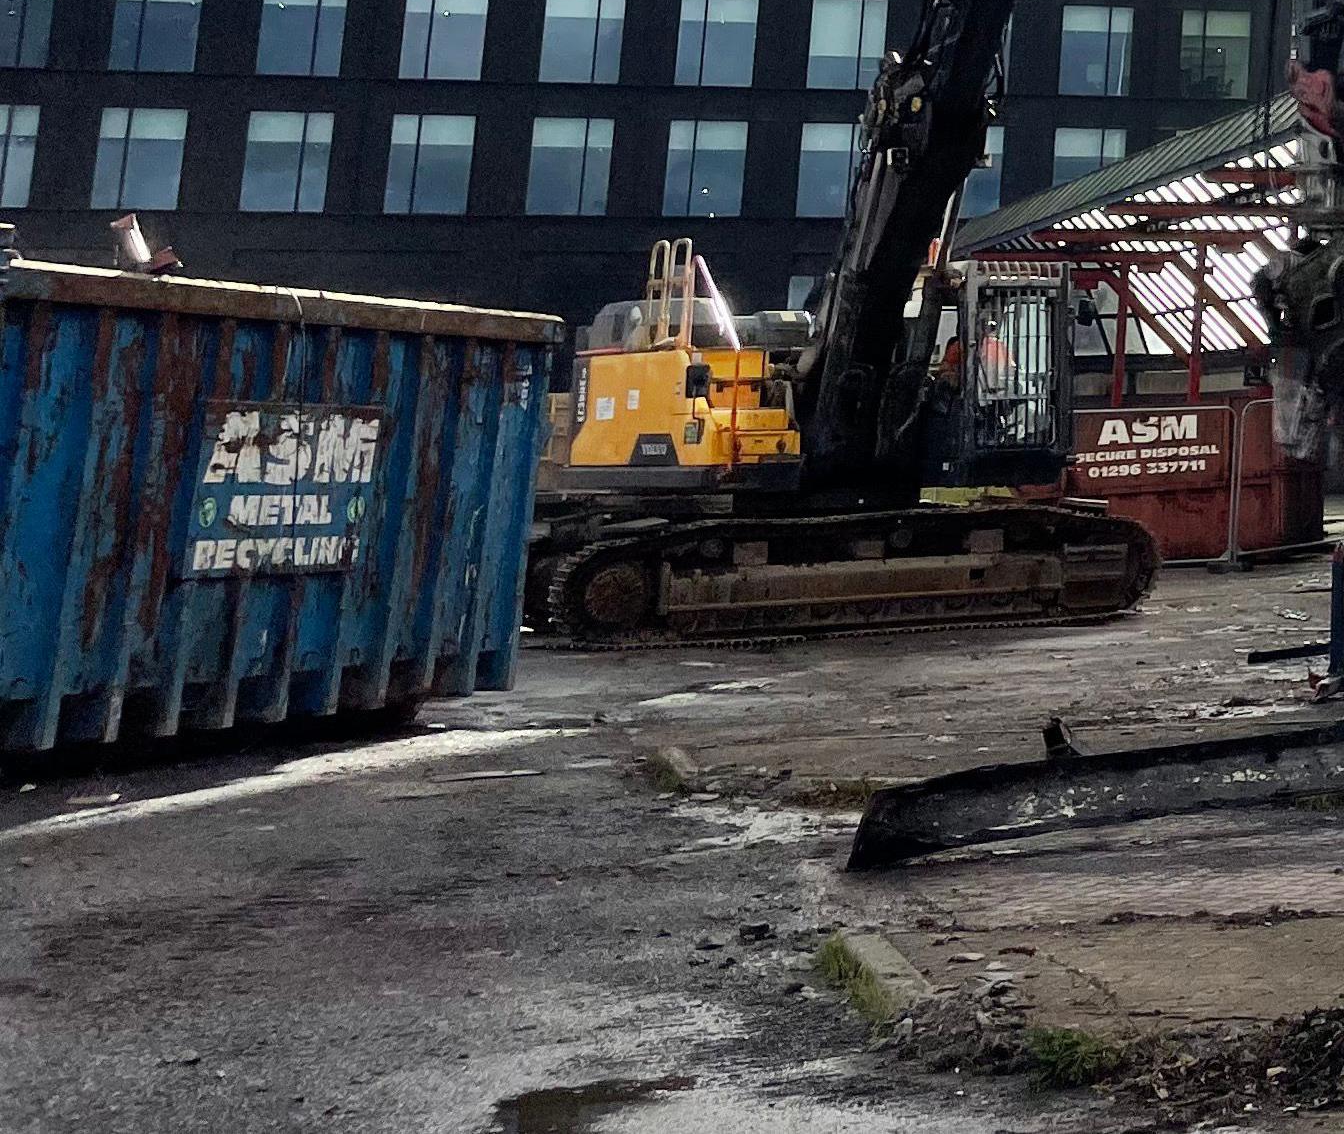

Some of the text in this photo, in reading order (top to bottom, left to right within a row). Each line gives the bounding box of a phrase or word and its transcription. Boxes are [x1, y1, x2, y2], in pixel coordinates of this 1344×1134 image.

[1097, 414, 1198, 446] ASM
[203, 410, 380, 485] ASM
[1076, 445, 1220, 463] SECURE DISPOSAL
[1089, 459, 1206, 478] 01296 337711
[226, 494, 332, 526] METAL
